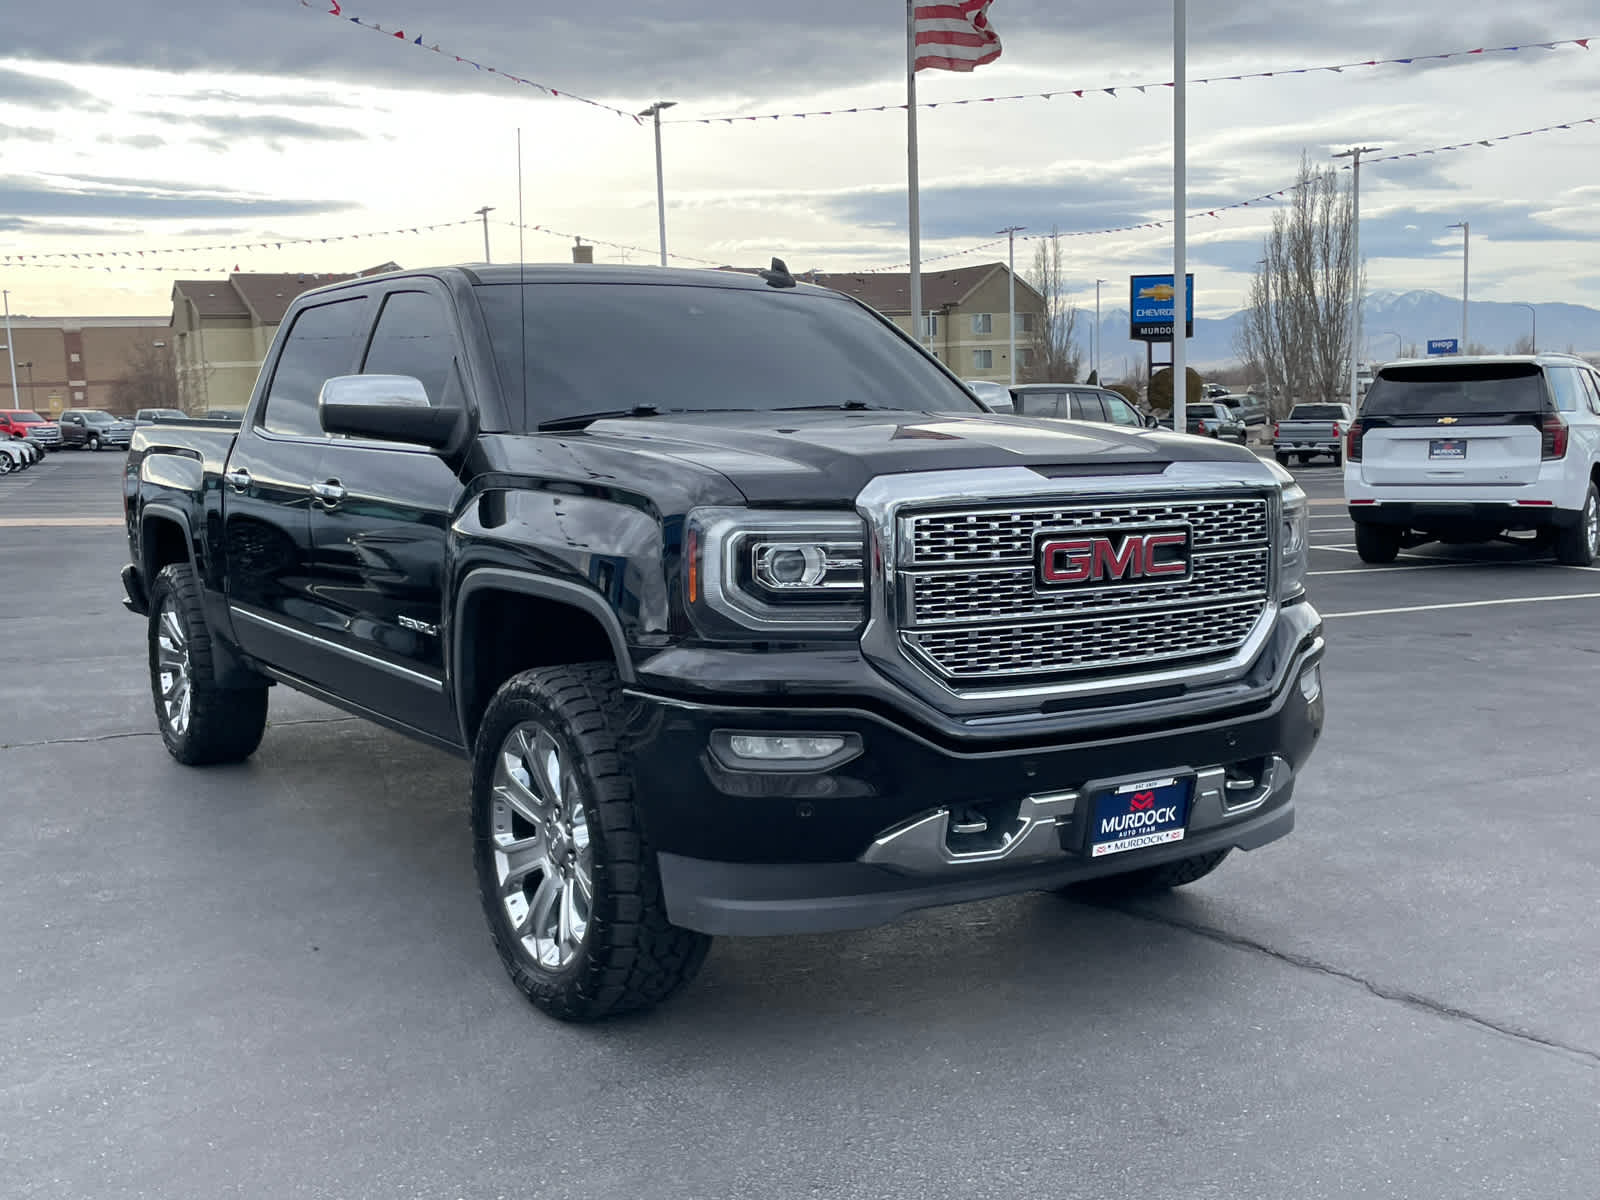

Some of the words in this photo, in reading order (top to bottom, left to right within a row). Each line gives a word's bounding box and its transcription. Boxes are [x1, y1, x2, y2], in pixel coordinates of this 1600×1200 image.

[1136, 308, 1176, 317] CHEVRO
[1041, 532, 1187, 584] GMC
[1101, 805, 1177, 834] MURDOCK
[1139, 826, 1156, 834] TEAM
[1113, 834, 1165, 850] MURDOCK
